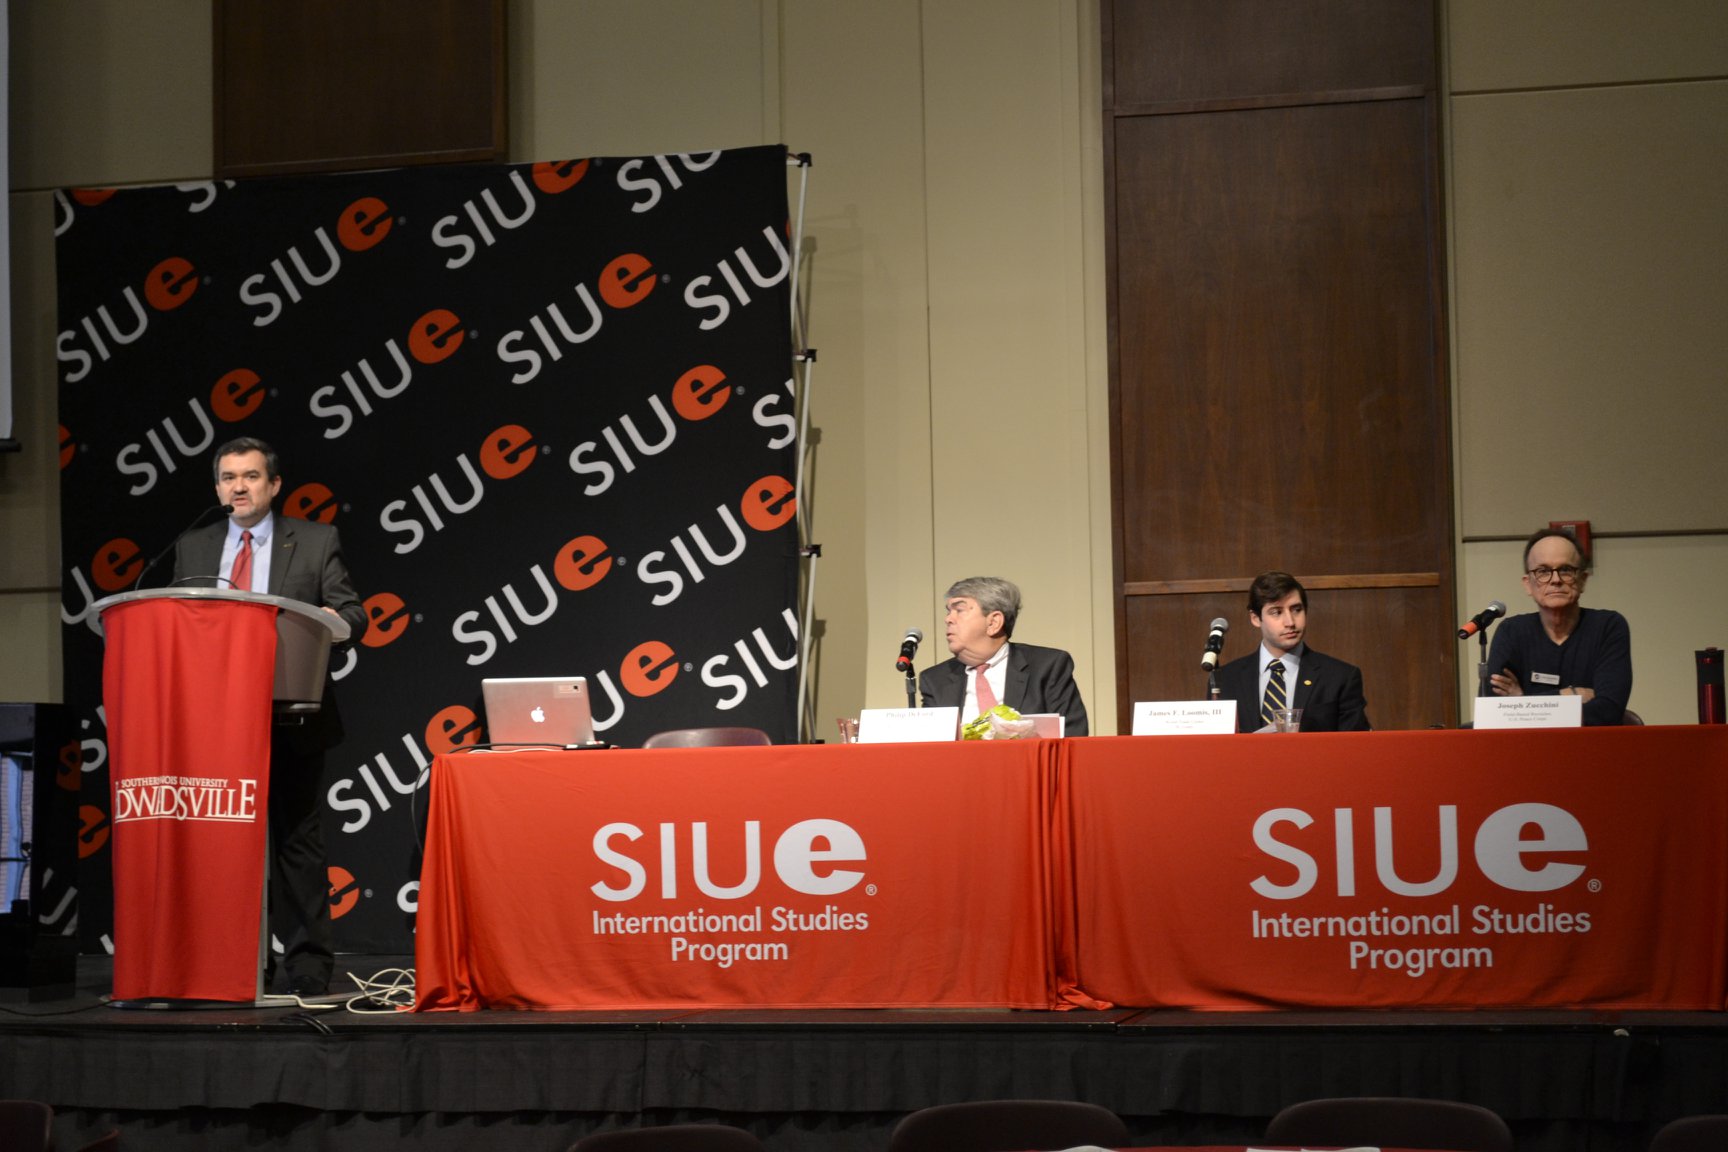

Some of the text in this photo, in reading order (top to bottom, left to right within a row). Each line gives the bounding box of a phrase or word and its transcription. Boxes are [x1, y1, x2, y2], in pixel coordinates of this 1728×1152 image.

[239, 197, 393, 327] SIUe
[684, 218, 791, 330] SIU
[309, 309, 465, 440] SIUe
[497, 253, 657, 384] SIUe
[116, 368, 265, 496] SIUe
[569, 365, 731, 496] SIUe
[379, 424, 537, 554] SIUe
[452, 535, 613, 666] SIUe
[179, 776, 229, 788] UNIVERSITY
[590, 818, 868, 902] SIUe
[1250, 802, 1589, 900] SIUe
[592, 904, 869, 935] International Studies
[671, 937, 789, 969] Program
[1252, 903, 1592, 938] International Studies
[1350, 941, 1494, 978] Program
